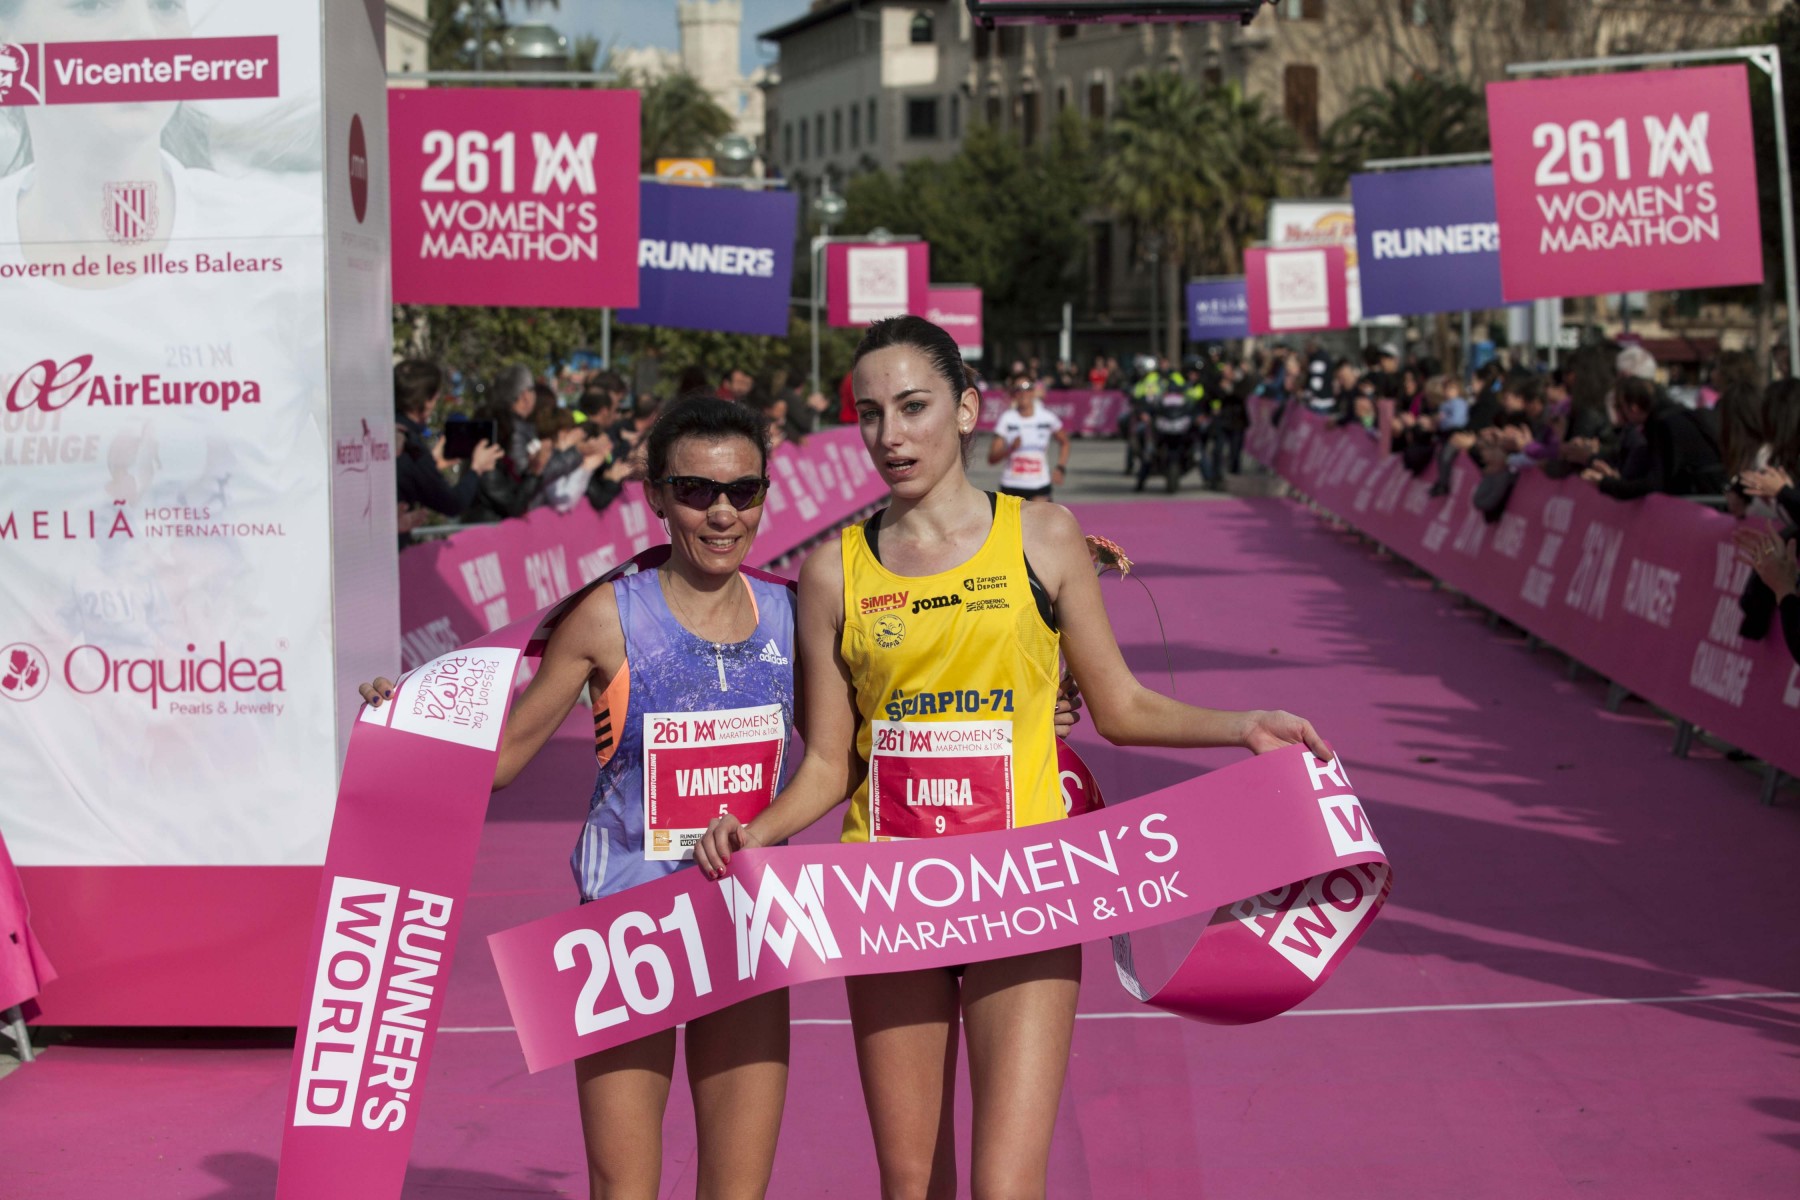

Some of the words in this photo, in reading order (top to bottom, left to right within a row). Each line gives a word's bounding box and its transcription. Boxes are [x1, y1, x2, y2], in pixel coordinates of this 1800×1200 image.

[54, 55, 268, 85] VicenteFerrer
[420, 130, 515, 193] 261
[1532, 118, 1631, 187] 261
[420, 200, 598, 233] WOMEN'S
[1536, 181, 1717, 224] WOMEN'S
[420, 231, 598, 261] MARATHON
[1539, 214, 1720, 254] MARATHON
[0, 261, 66, 278] overn
[72, 255, 98, 276] de
[106, 254, 137, 275] les
[143, 253, 189, 275] Illes
[195, 252, 283, 273] Balears
[87, 374, 261, 411] AirEuropa
[145, 507, 211, 521] HOTELS
[145, 523, 286, 538] INTERNATIONAL
[976, 575, 1007, 584] Zaragoza
[976, 598, 1006, 606] GOBIERNO
[759, 653, 788, 665] adidas
[63, 641, 286, 710] Orquidea
[169, 701, 214, 715] Pearls
[217, 702, 228, 714] &
[233, 701, 285, 717] Jewelry
[717, 713, 779, 730] WOMEN'S
[653, 721, 688, 744] 261
[718, 730, 761, 740] MARATHON
[877, 728, 904, 751] 261
[934, 728, 1004, 742] WOMEN'S
[935, 744, 983, 752] MARATHON
[675, 763, 763, 797] VANESSA
[906, 778, 974, 807] LAURA
[935, 815, 946, 834] 9
[831, 812, 1180, 914] WOMEN'S
[858, 897, 1079, 956] MARATHON
[552, 891, 713, 1037] 261
[305, 893, 388, 1115] WORLD
[361, 888, 454, 1132] RUNNER'S
